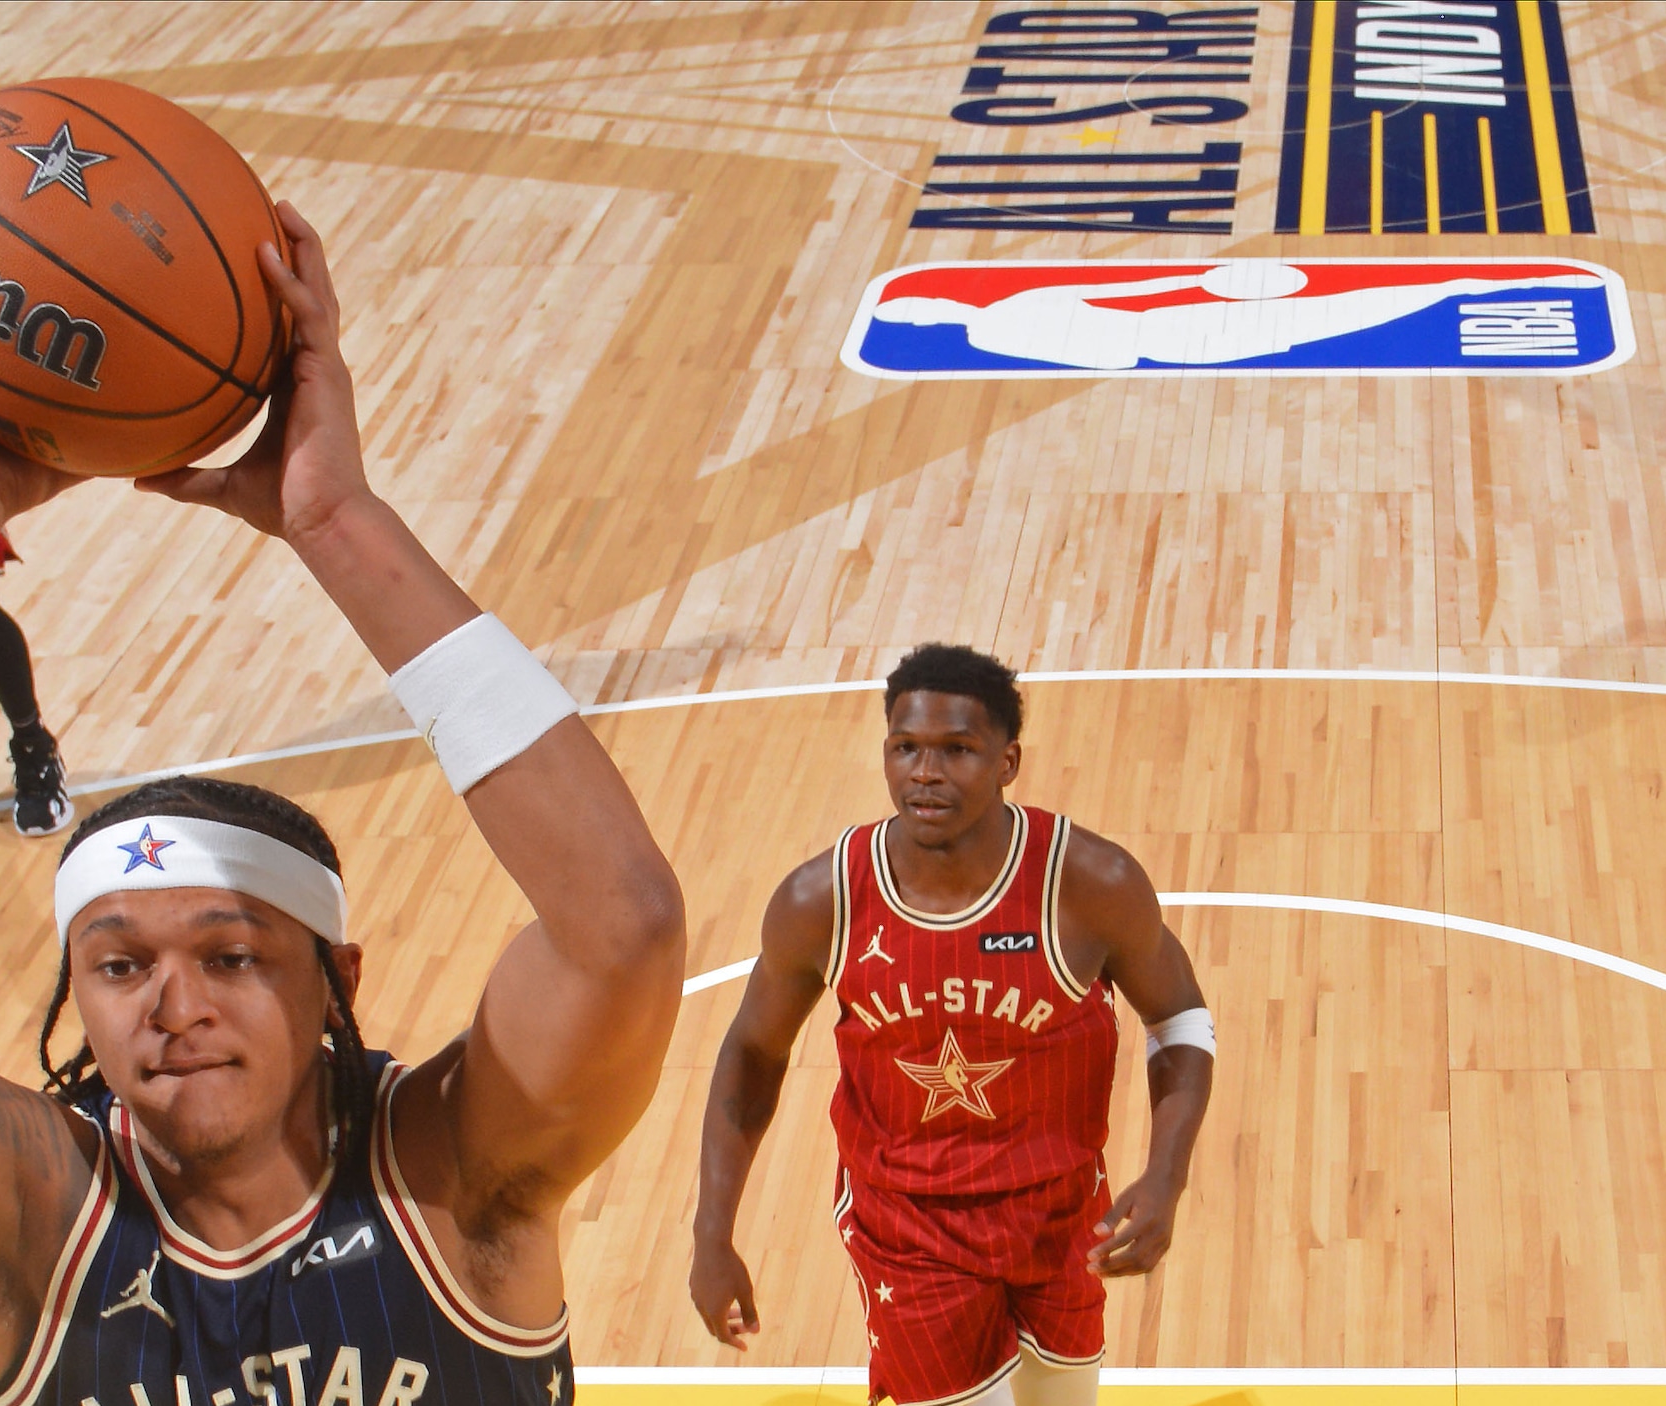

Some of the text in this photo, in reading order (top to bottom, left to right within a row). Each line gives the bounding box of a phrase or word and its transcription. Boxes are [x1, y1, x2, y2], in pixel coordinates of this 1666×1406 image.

[908, 7, 1258, 235] ALL STAR
[1458, 300, 1579, 356] NBA
[984, 935, 1034, 951] KIA
[850, 977, 1054, 1034] ALL-STAR
[290, 1224, 375, 1278] KIA
